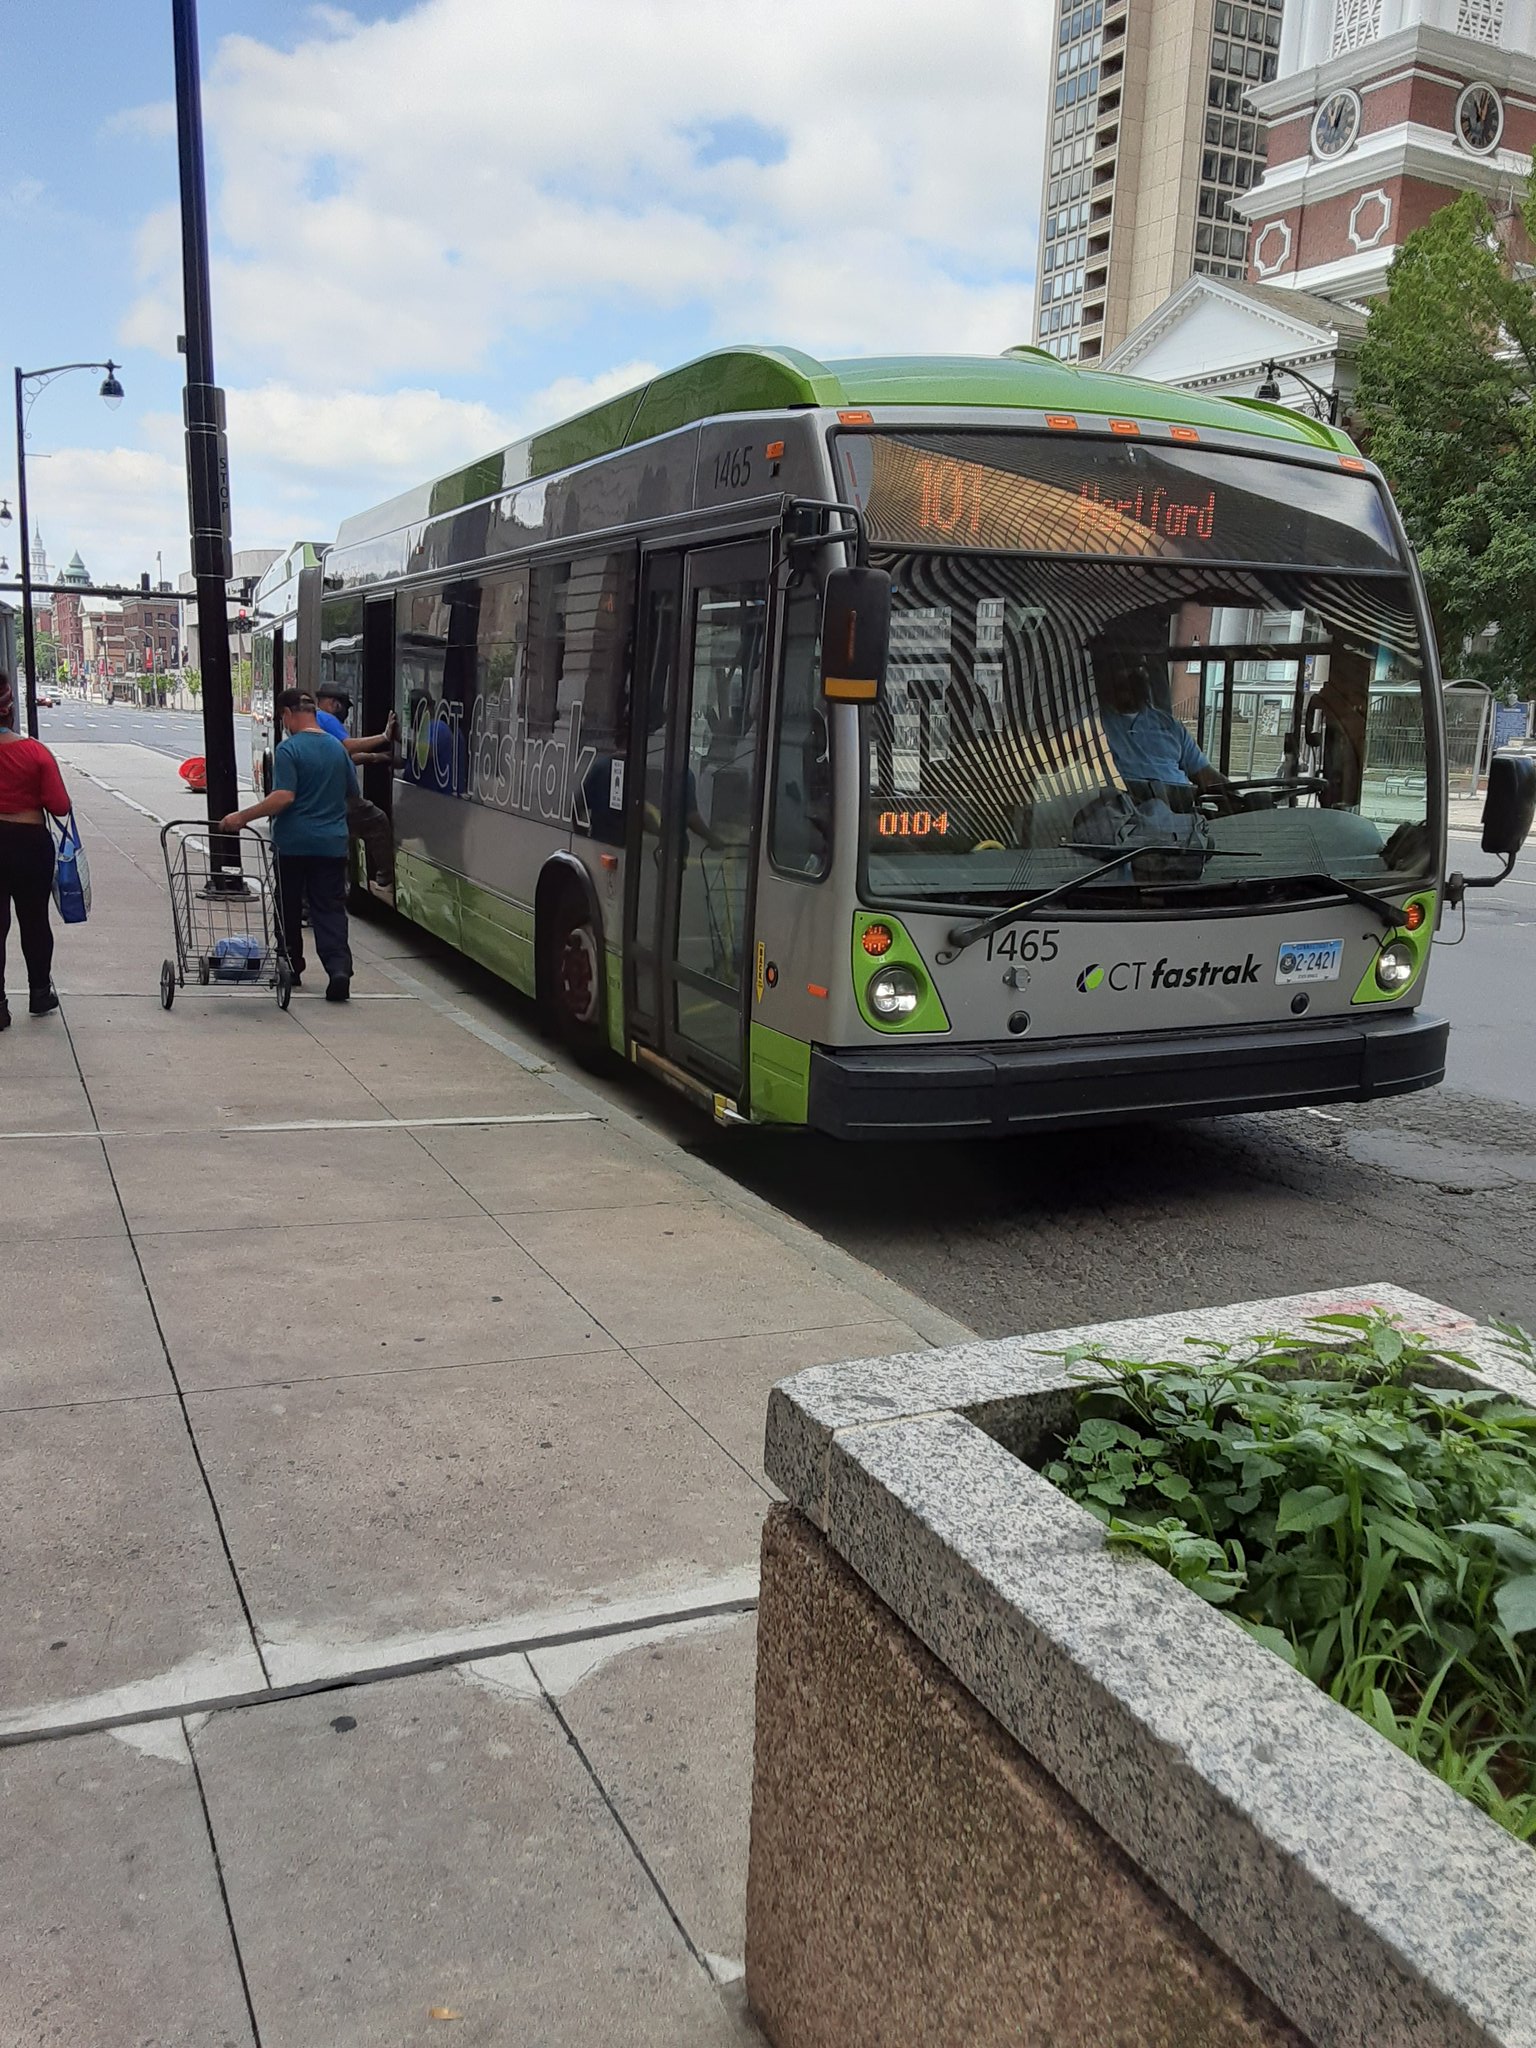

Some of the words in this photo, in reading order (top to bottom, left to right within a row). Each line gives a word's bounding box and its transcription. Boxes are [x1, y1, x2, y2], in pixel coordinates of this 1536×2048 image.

[219, 457, 229, 514] STOP
[714, 446, 753, 489] 1465
[915, 459, 984, 531] 101
[1079, 482, 1216, 538] Hartford
[432, 698, 464, 790] CT
[467, 694, 597, 828] fastrak
[879, 810, 950, 835] 0104
[983, 929, 1060, 962] 1465
[1295, 950, 1336, 971] 2-2421
[1108, 961, 1147, 991] CT
[1150, 953, 1263, 989] fastrak
